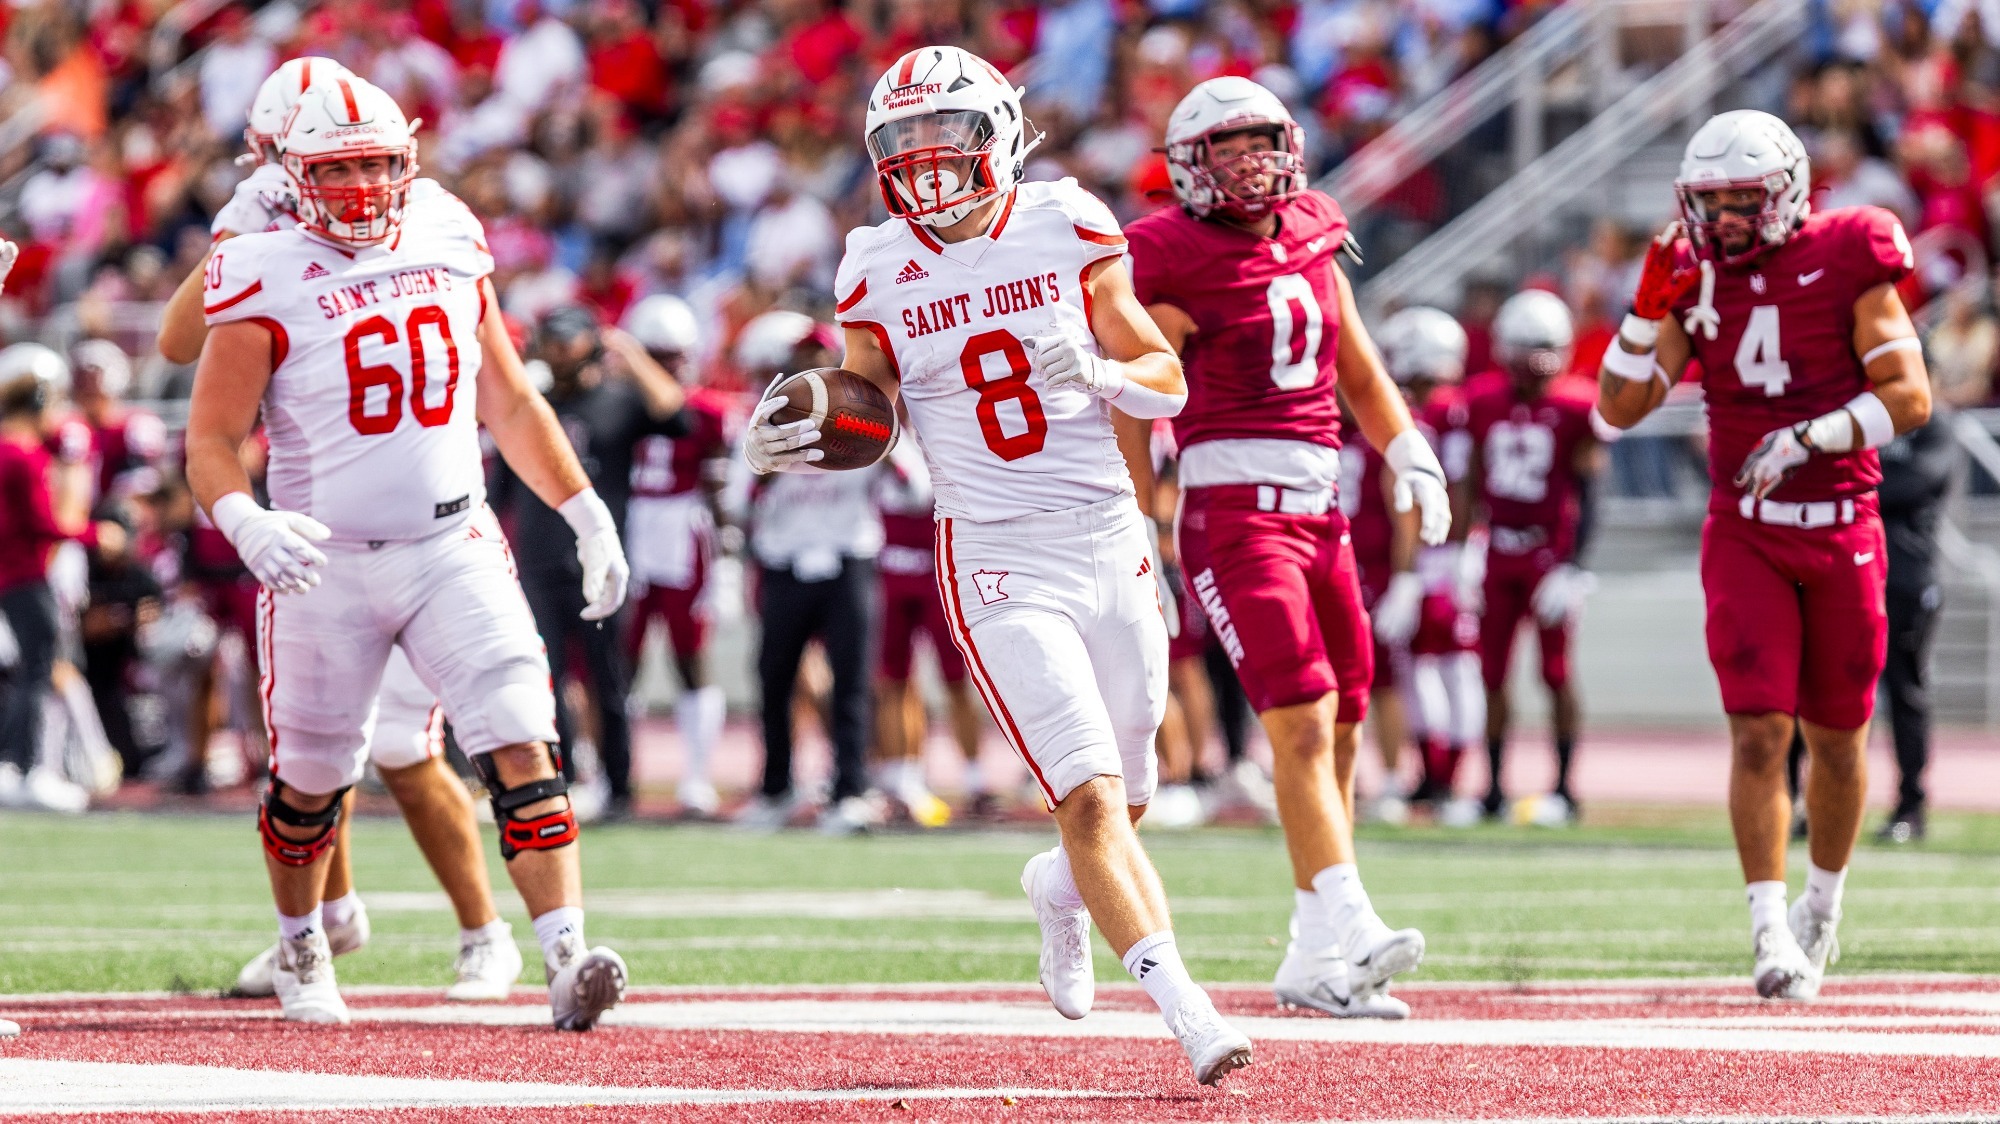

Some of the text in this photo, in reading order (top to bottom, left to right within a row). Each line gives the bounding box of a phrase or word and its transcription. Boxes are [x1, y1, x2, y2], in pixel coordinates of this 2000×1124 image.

[882, 83, 943, 106] BOHMERT
[888, 95, 924, 111] Riddell
[317, 267, 453, 319] SAINT JOHN'S
[895, 270, 930, 285] adidas
[902, 272, 1061, 339] SAINT JOHN'S
[344, 304, 460, 436] 60
[1266, 272, 1323, 391] 0
[1733, 304, 1792, 397] 4
[959, 328, 1048, 462] 8
[1192, 566, 1246, 671] HAMLINE
